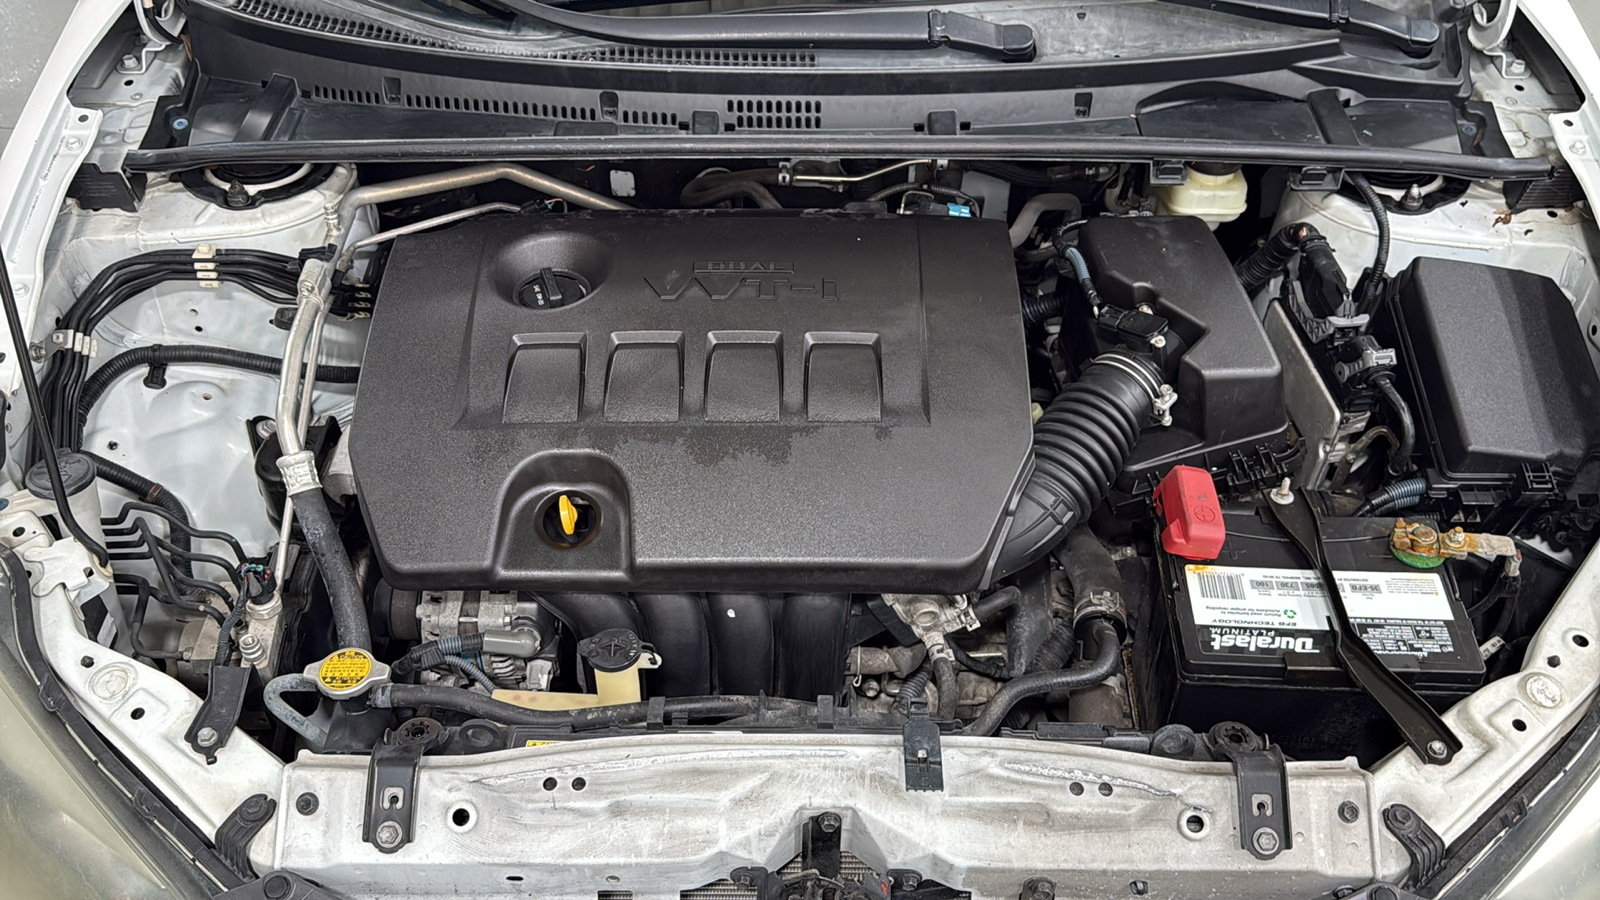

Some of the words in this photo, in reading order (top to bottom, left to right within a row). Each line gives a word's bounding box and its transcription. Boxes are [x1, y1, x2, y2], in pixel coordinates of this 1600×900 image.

[707, 261, 786, 271] DUAL
[1211, 618, 1275, 626] TECHNOLOGY
[1210, 634, 1320, 653] Duralast
